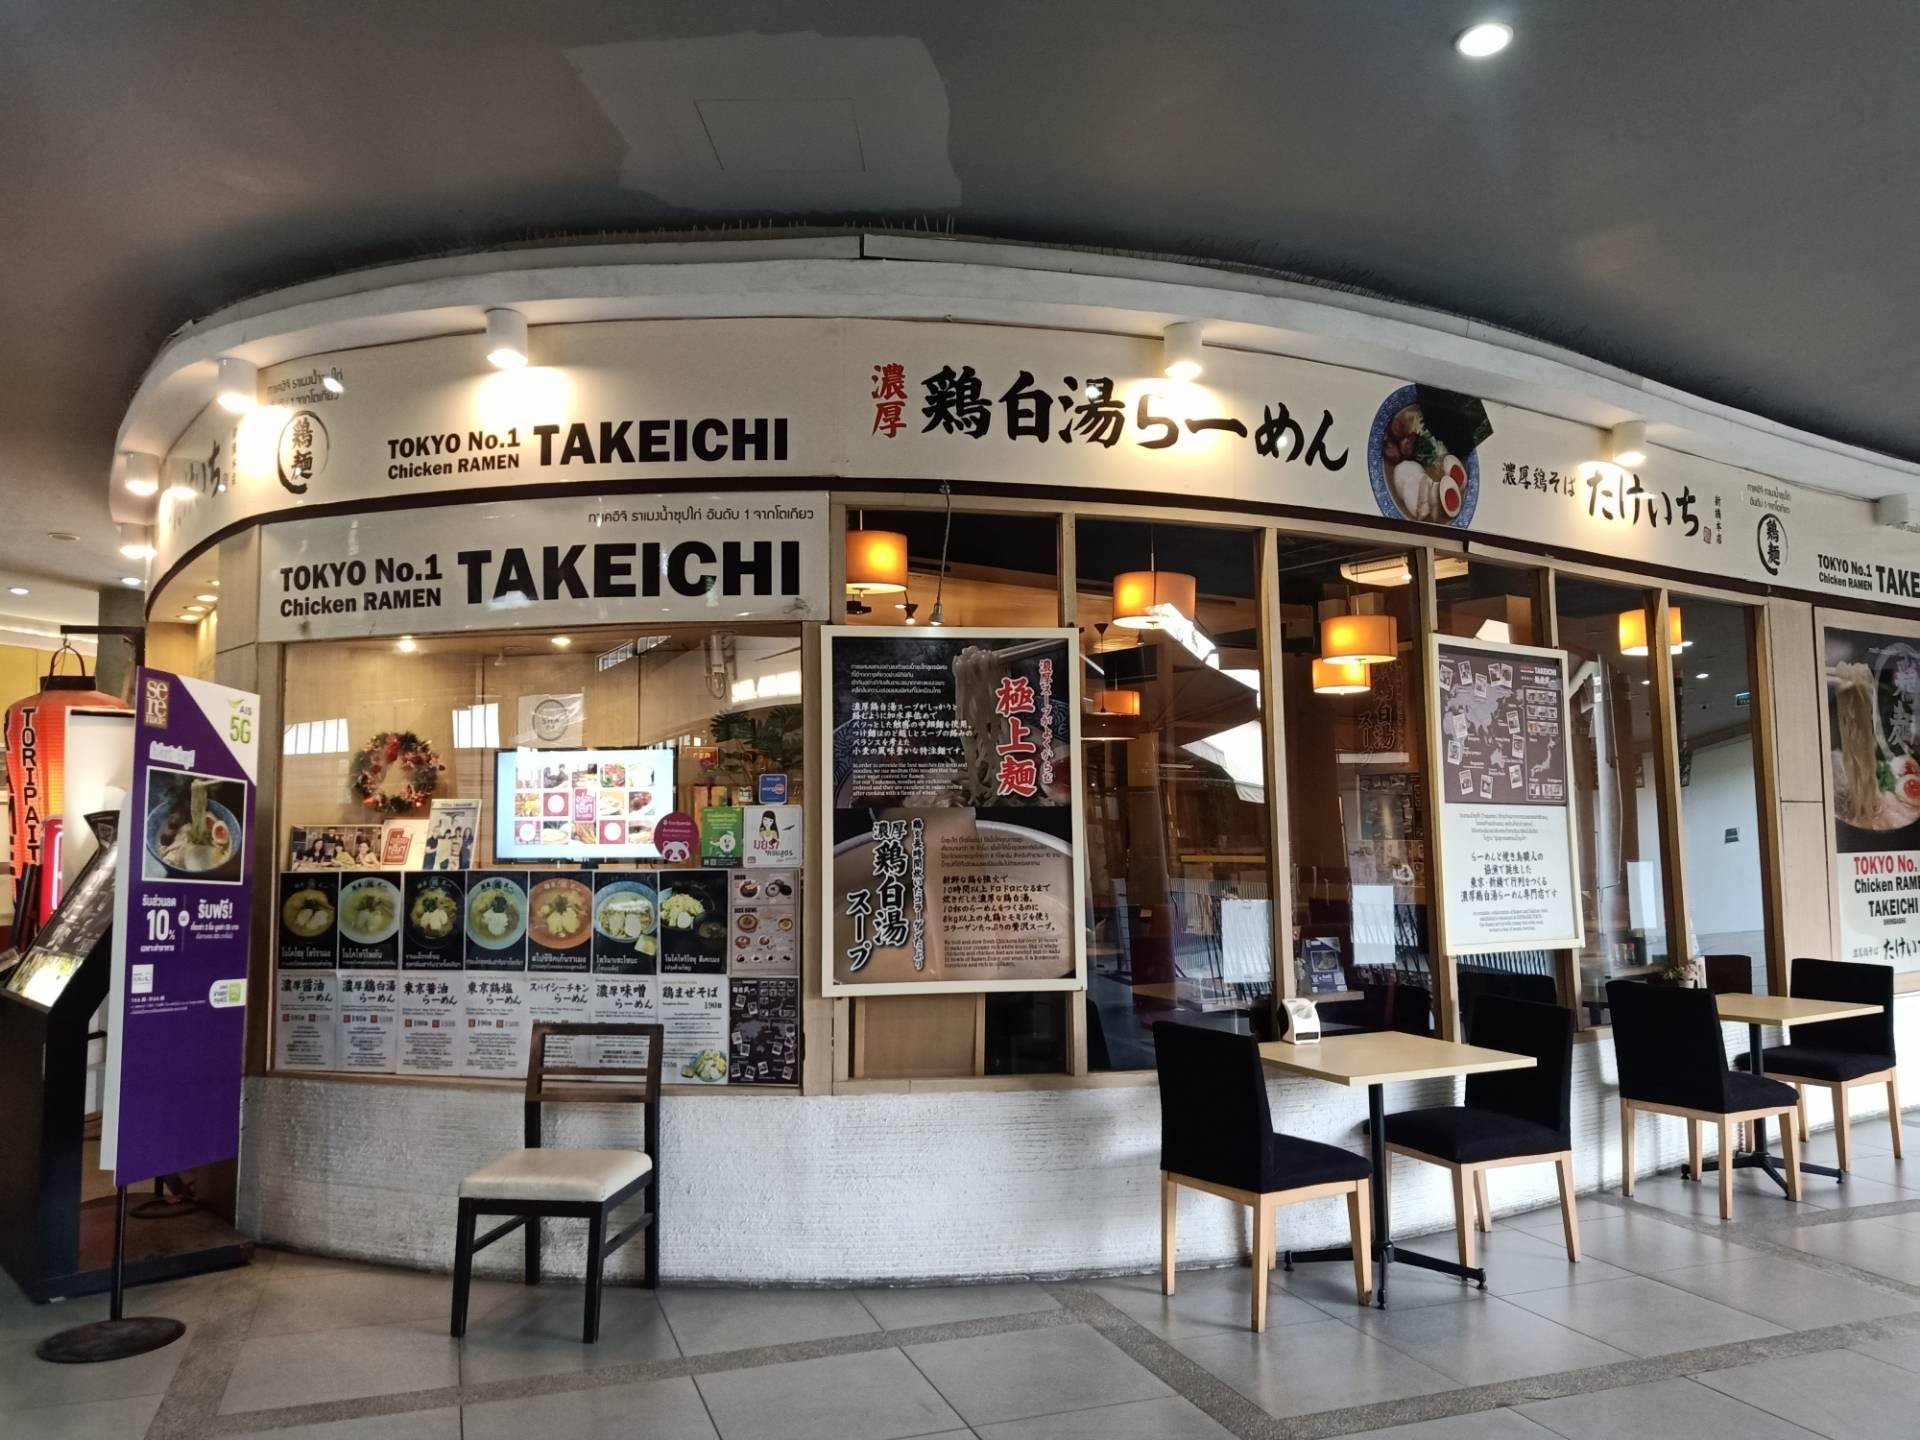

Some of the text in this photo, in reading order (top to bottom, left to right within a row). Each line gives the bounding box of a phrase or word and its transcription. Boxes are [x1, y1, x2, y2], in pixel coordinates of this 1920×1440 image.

[871, 363, 908, 439] 濃厚
[920, 364, 1349, 472] 鶏白湯らーめん
[388, 418, 788, 467] TOKYO No.1 TAKEICHI
[388, 453, 520, 480] Chicken RAMEN
[745, 509, 749, 519] 1
[1586, 472, 1700, 538] たけいち
[280, 540, 800, 605] TOKYO No.1 TAKEICHI
[1818, 554, 1849, 574] TOKYO
[1851, 561, 1873, 578] No.1
[1819, 571, 1873, 592] Chicken RAMEN
[280, 587, 442, 618] Chicken RAMEN
[239, 705, 252, 716] AIS
[230, 716, 251, 744] 5G
[995, 676, 1038, 797] 極上麺
[1853, 855, 1894, 875] TOKYO
[872, 839, 909, 946] 鶏白湯
[1854, 877, 1893, 894] Chicken
[1868, 897, 1919, 918] TAKEICHI
[846, 888, 873, 971] スープ
[1883, 936, 1920, 961] たけい
[298, 992, 333, 1002] らーめん
[359, 993, 395, 1003] らーめん
[530, 982, 590, 993] スパイシーチキン
[554, 993, 588, 1003] らーめん
[422, 995, 458, 1005] らーめん
[486, 994, 522, 1005] らーめん
[615, 999, 654, 1009] らーめん
